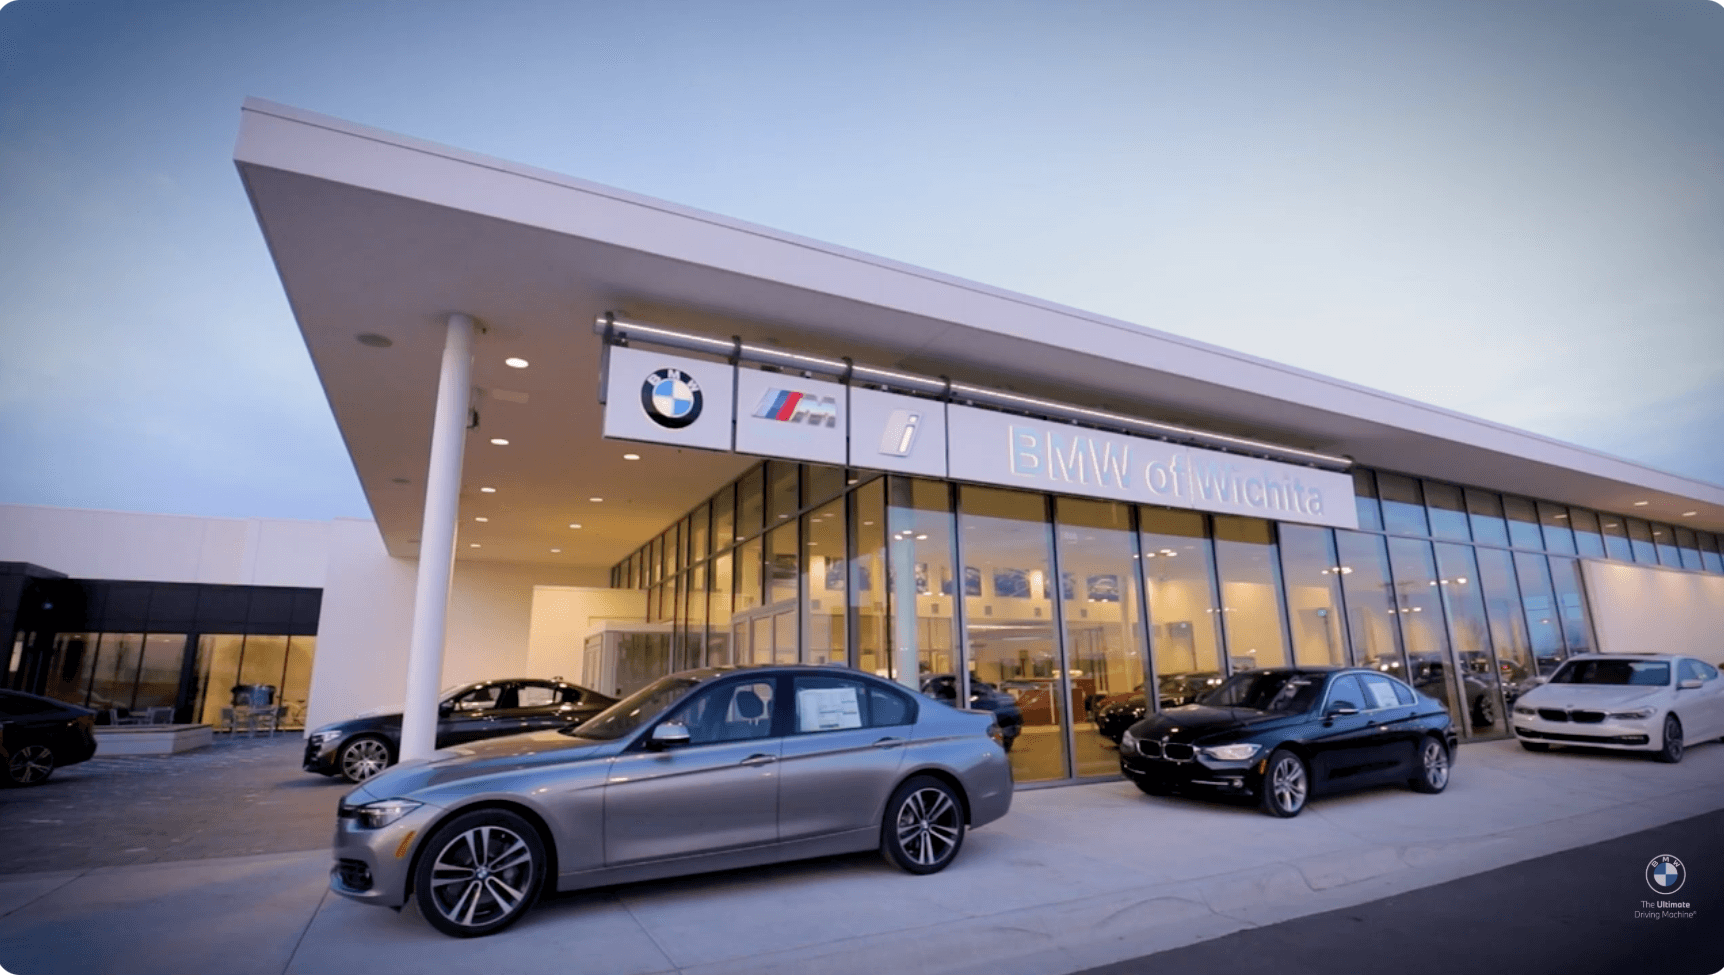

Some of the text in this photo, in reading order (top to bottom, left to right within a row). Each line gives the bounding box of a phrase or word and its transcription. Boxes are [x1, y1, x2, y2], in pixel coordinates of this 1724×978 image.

[647, 369, 700, 392] BMW
[1009, 425, 1324, 516] BMW of Wichita
